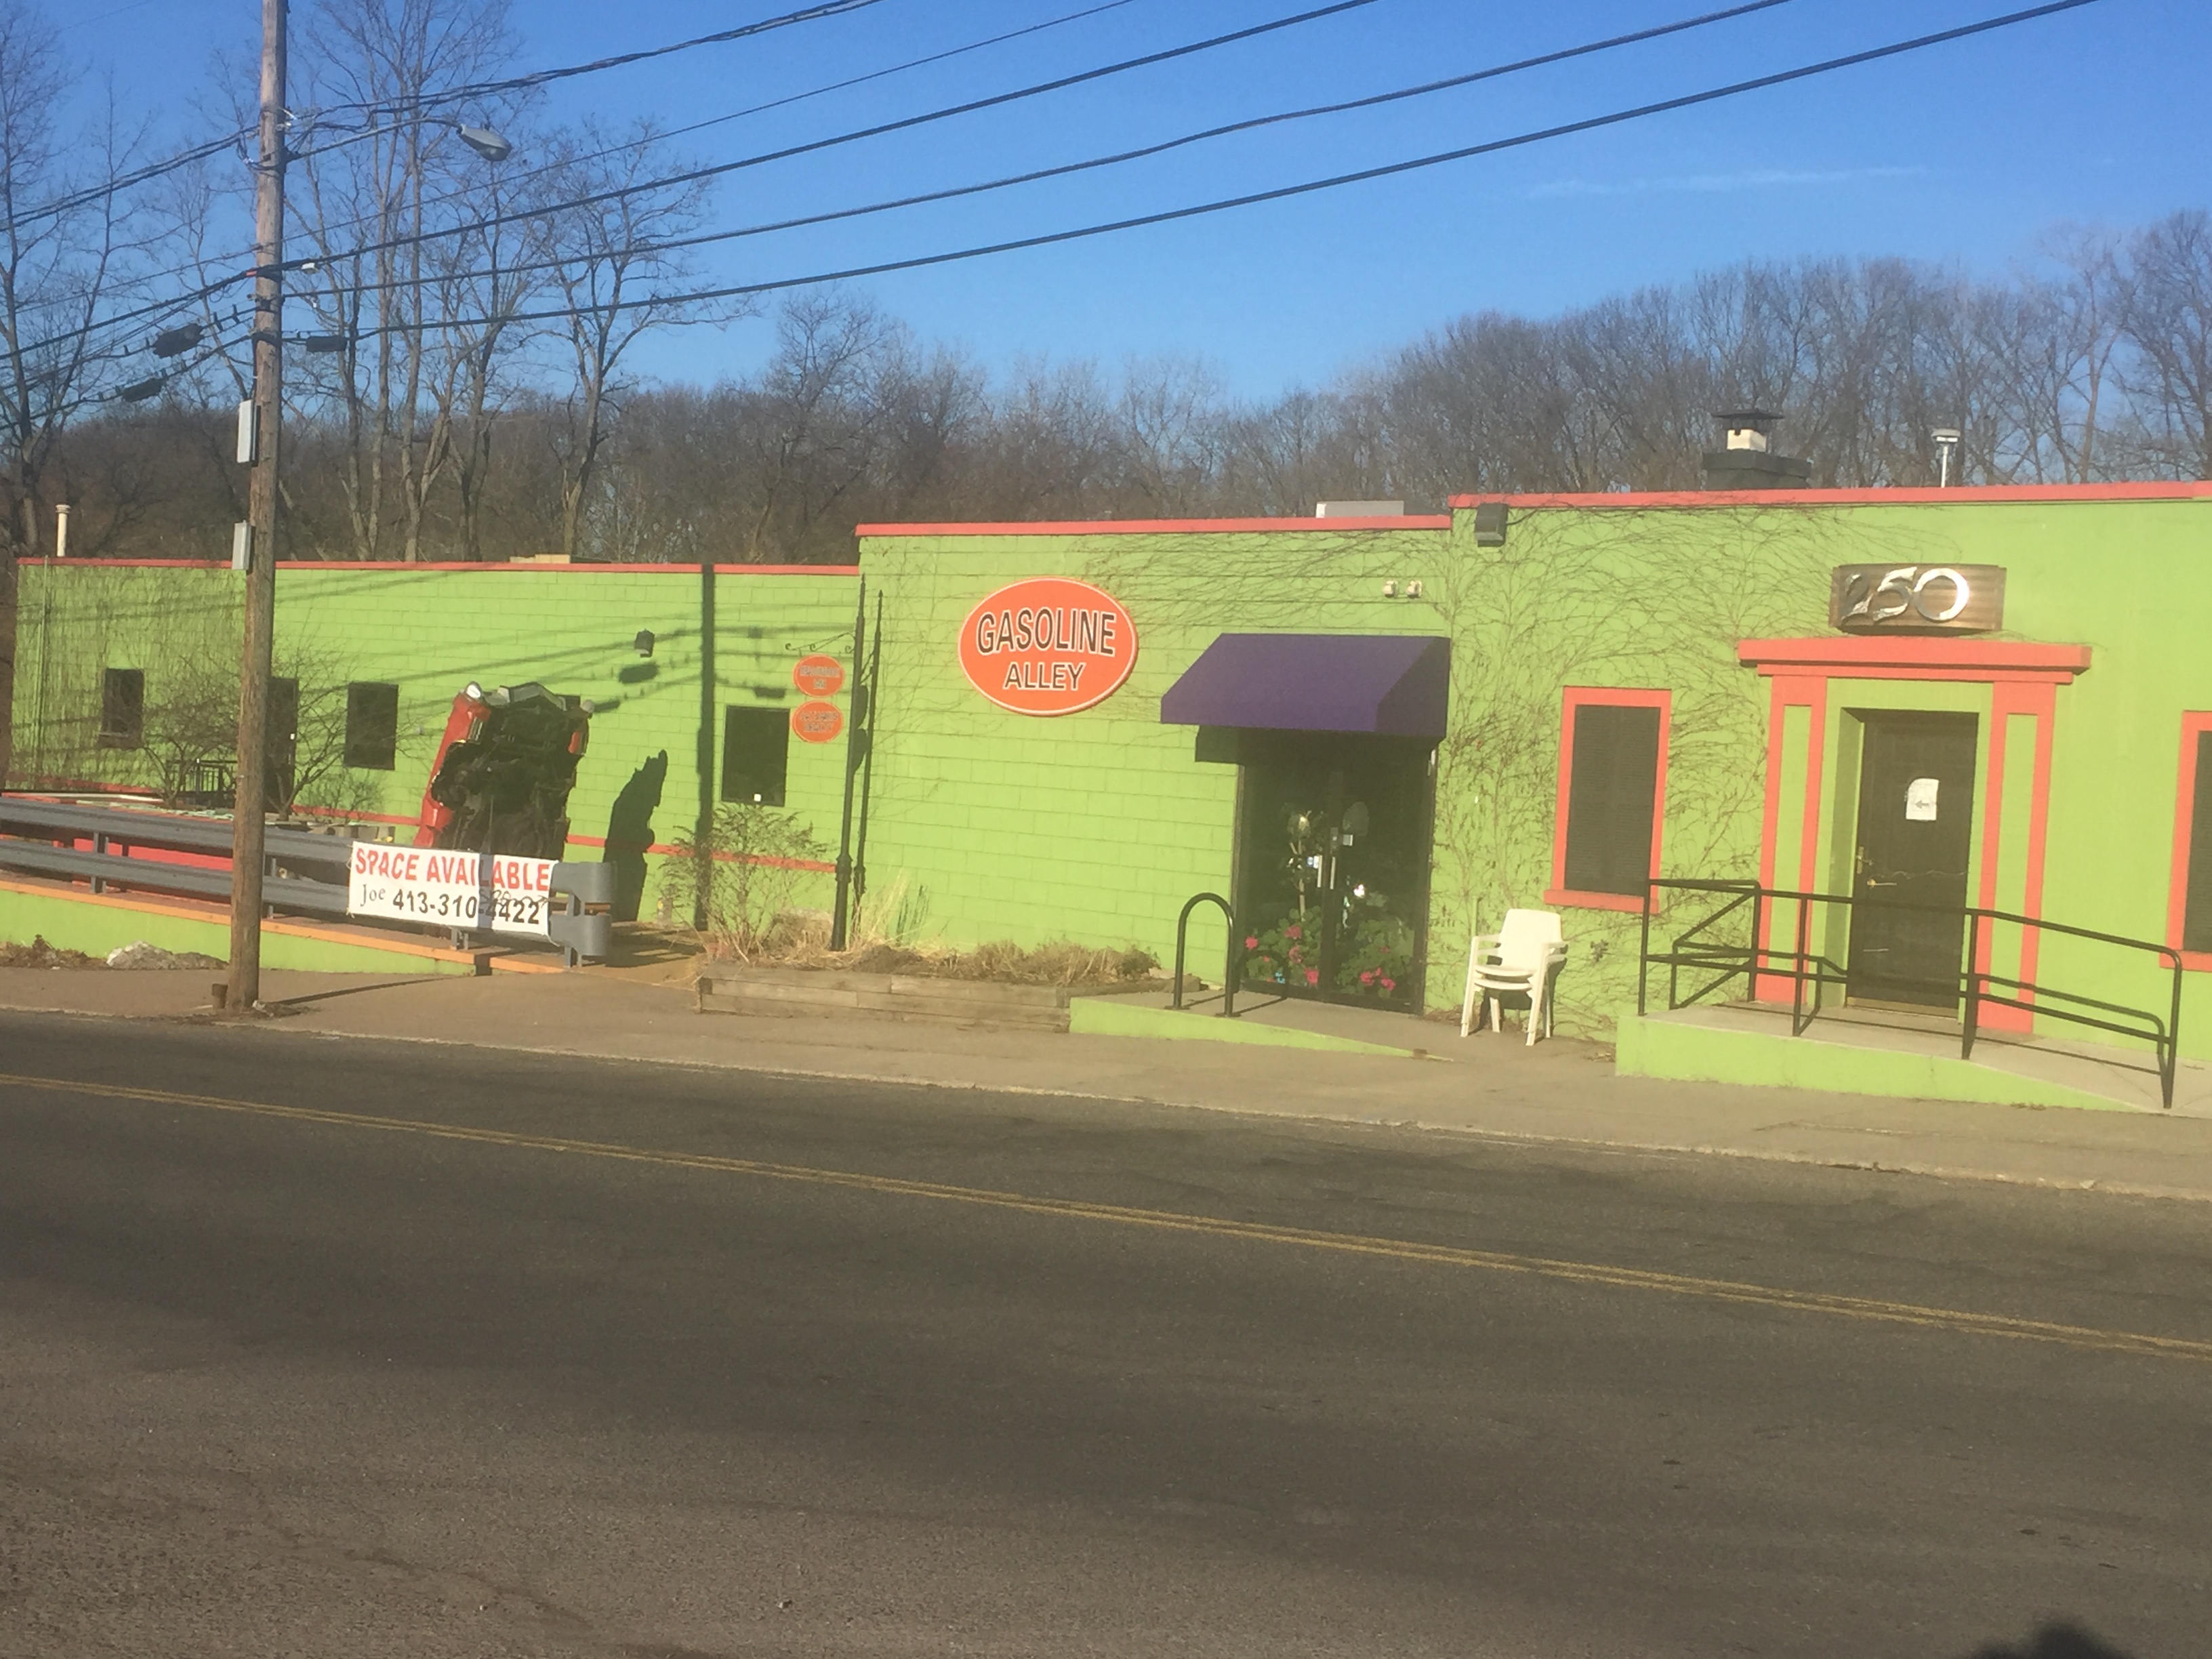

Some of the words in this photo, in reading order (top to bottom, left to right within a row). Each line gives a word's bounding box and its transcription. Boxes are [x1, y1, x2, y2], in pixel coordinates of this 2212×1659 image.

[1841, 567, 1969, 623] 250
[977, 607, 1116, 657] GASOLINE
[1003, 661, 1086, 691] ALLEY
[356, 848, 420, 880] SPACE
[427, 855, 550, 892] AVAILABLE
[360, 884, 386, 907] Joe
[392, 888, 539, 924] 413-310-4422
